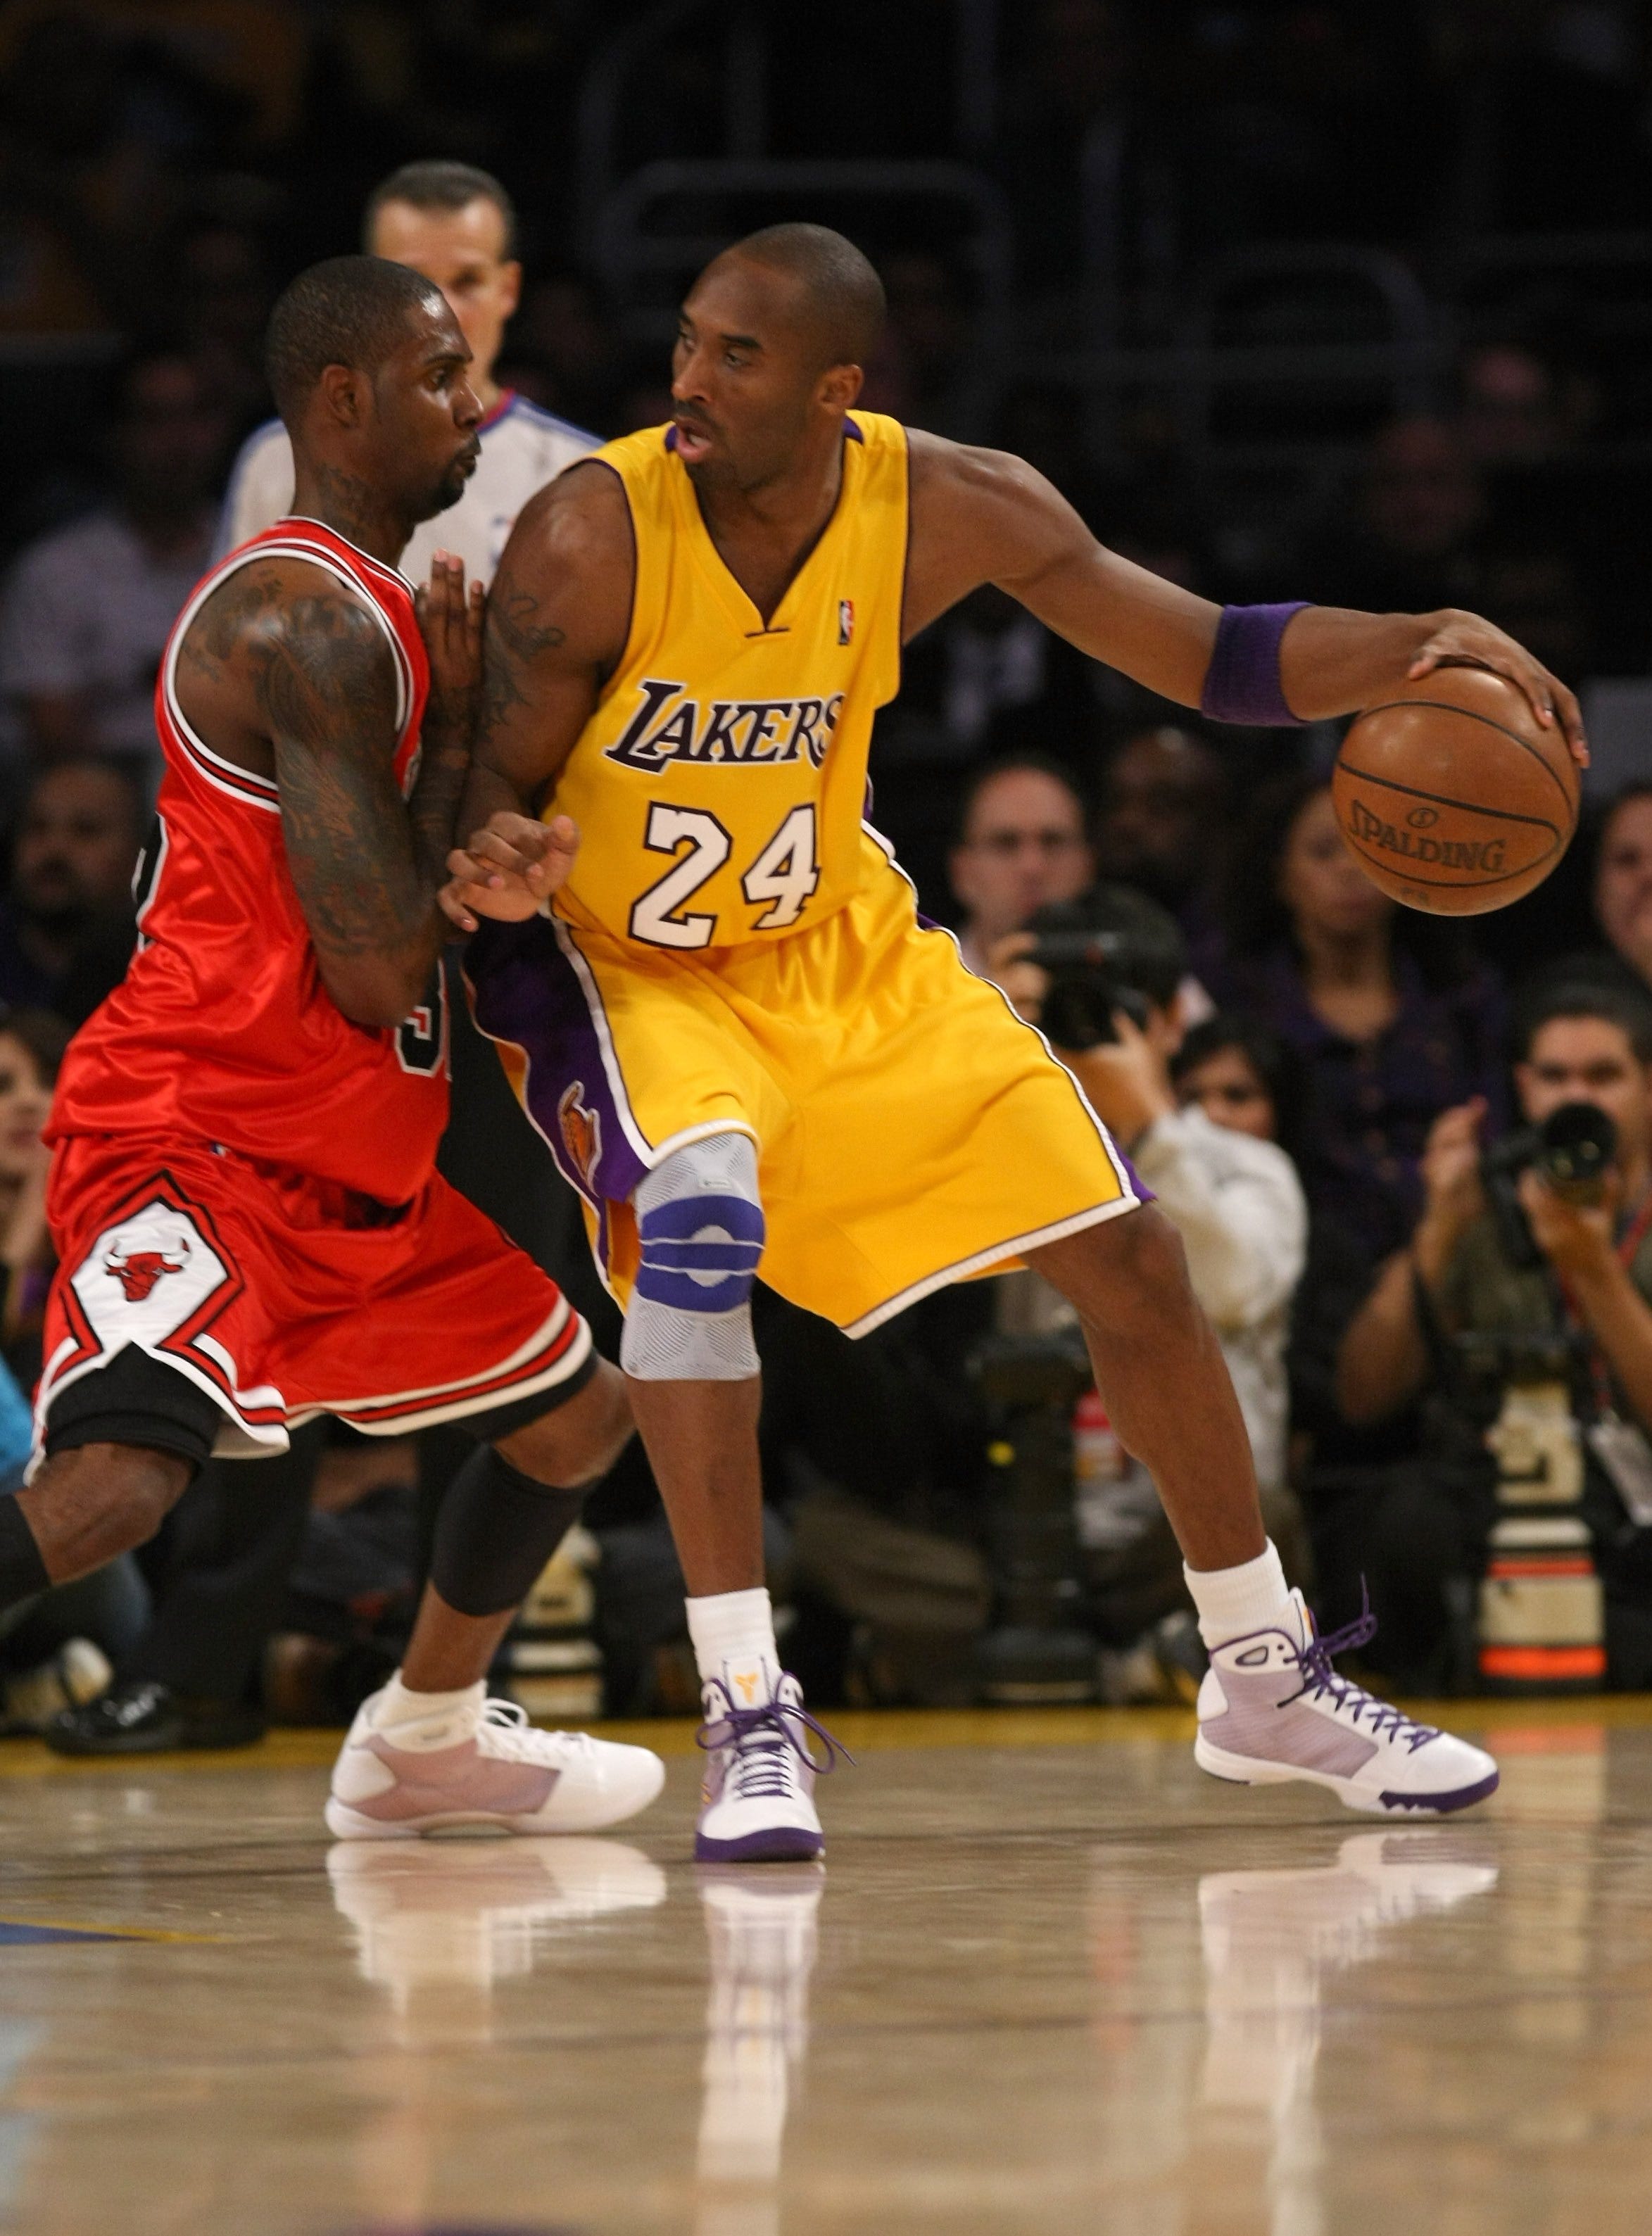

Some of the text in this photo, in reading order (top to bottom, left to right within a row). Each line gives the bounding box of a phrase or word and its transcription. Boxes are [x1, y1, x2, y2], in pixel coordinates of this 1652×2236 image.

[602, 678, 845, 776] LAKERS
[628, 800, 820, 952] 24
[1348, 799, 1507, 873] SPALDING
